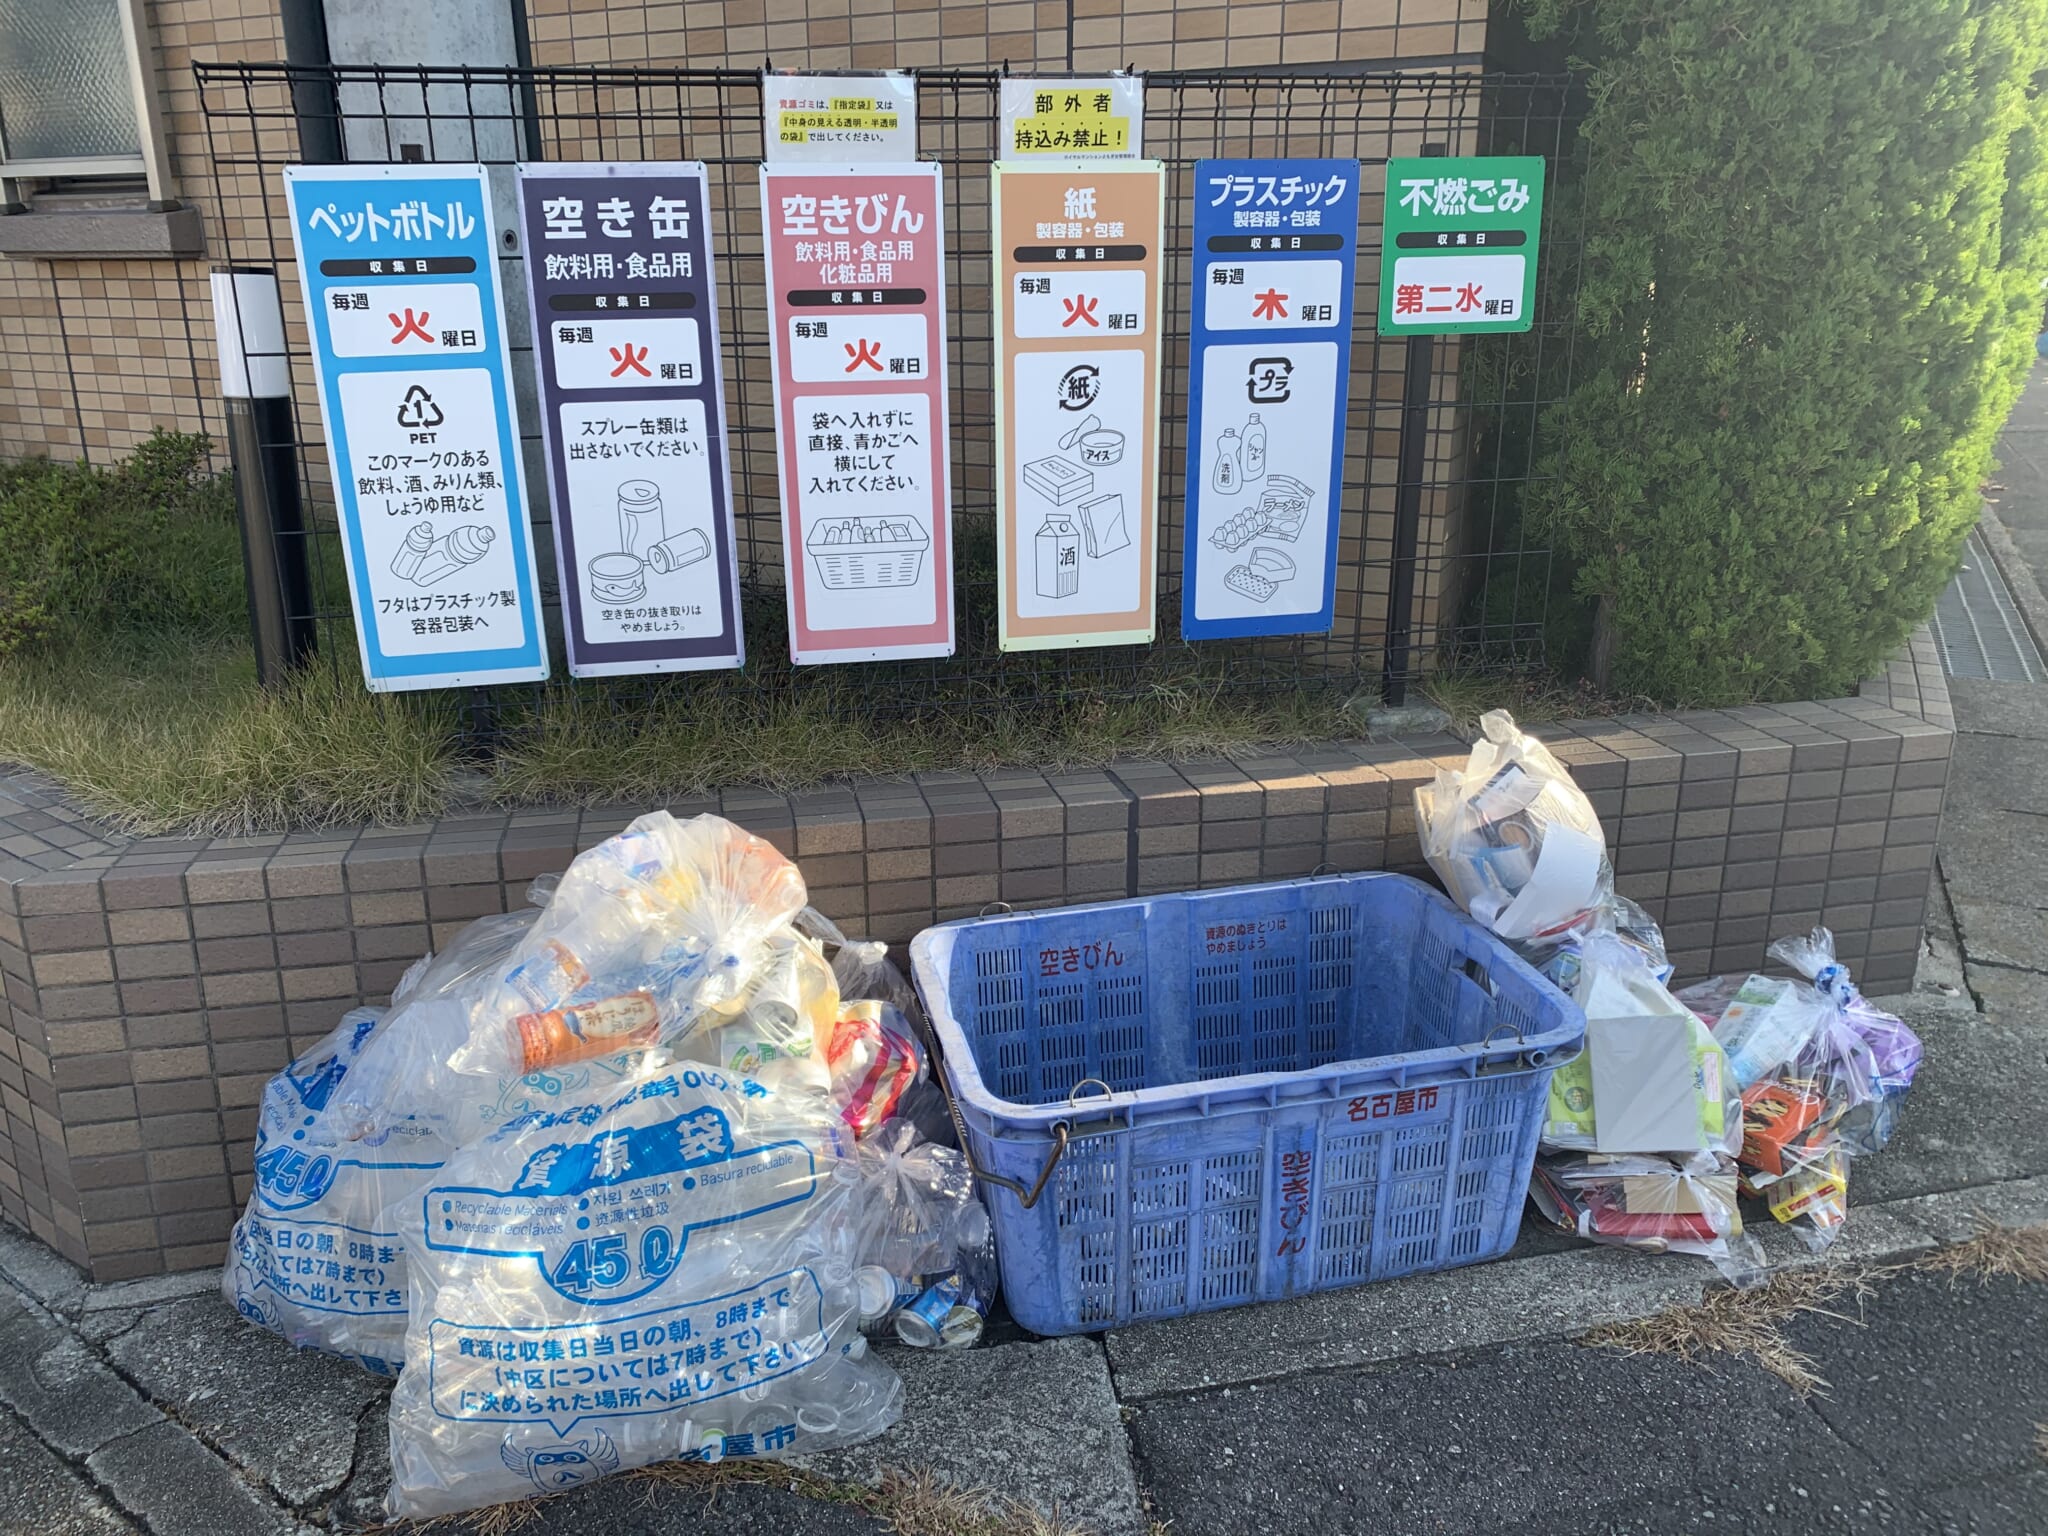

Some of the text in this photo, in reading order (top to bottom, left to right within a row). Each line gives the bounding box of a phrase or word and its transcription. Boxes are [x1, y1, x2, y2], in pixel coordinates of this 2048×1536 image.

[1035, 93, 1111, 114] 部外者
[1209, 174, 1347, 207] プラスチック
[1399, 177, 1530, 217] 不燃ごみ
[1064, 187, 1096, 219] 紙
[309, 201, 475, 242] ペットボトル
[542, 196, 690, 239] 空き缶
[781, 193, 924, 236] 空きびん
[1250, 237, 1301, 249] 収集日
[1437, 233, 1486, 245] 収集日
[1055, 248, 1105, 260] 収集日
[369, 260, 428, 273] 収集日
[820, 262, 893, 285] 化粧品用
[1212, 268, 1244, 285] 毎週
[1020, 278, 1051, 294] 毎週
[332, 293, 370, 311] 毎週
[595, 296, 651, 308] 収集日
[831, 291, 883, 303] 収集日
[558, 327, 594, 343] 毎週
[795, 322, 828, 338] 毎週
[1068, 376, 1090, 400] 紙
[1259, 369, 1289, 391] プラ
[581, 417, 689, 436] スプレー缶類は
[812, 410, 913, 430] 袋へ入れずに
[409, 433, 437, 444] PET
[808, 433, 919, 452] 直接、青かごへ
[368, 449, 490, 471] このマークのある
[570, 440, 705, 460] 出さないでください。
[1086, 449, 1110, 461] アイス
[834, 454, 896, 473] 横にして
[358, 471, 504, 496] 飲料、酒、みりん類、
[809, 475, 919, 495] 入れてください。
[386, 494, 485, 516] しょうゆ用など
[1264, 498, 1305, 512] ラーメン
[1060, 546, 1076, 566] 酒
[378, 590, 517, 614] フタはプラスチック製
[601, 605, 702, 621] 空き缶の抜き取りは
[411, 615, 489, 635] 容器包装へ
[1206, 936, 1266, 956] やめましょう
[1039, 940, 1124, 977] 空きびん
[1347, 1086, 1440, 1122] 名古屋市
[519, 1111, 728, 1191] 資源袋
[700, 1168, 744, 1188] Basura
[454, 1200, 512, 1216] Recyclable
